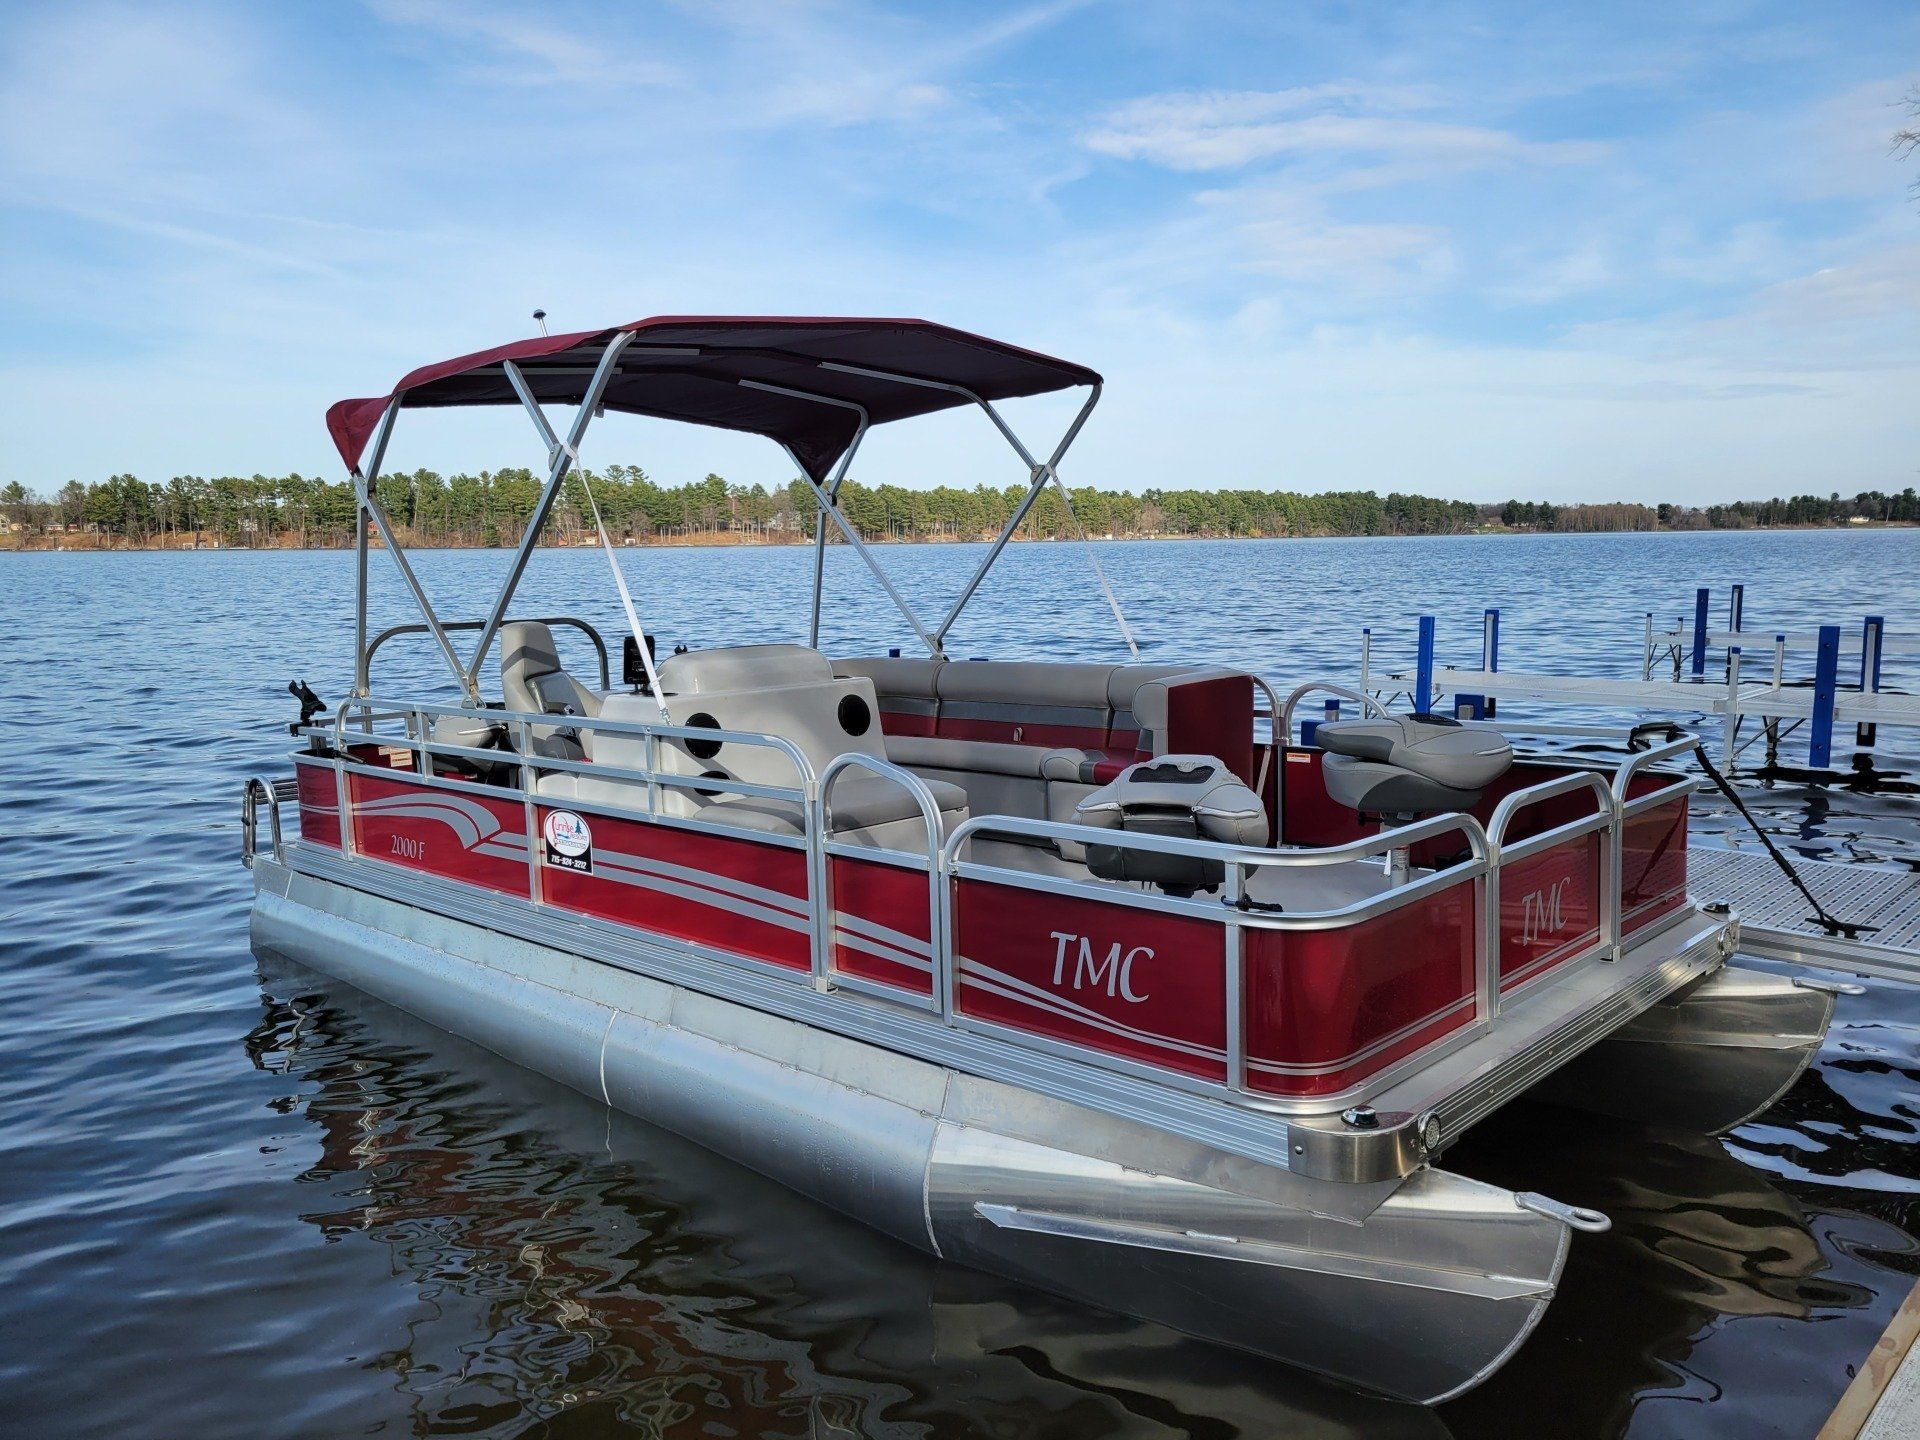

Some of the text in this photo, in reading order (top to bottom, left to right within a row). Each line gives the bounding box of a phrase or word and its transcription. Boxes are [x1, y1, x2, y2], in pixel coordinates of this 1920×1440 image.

[391, 834, 426, 861] 2000 F
[1522, 876, 1571, 947] TMC
[1050, 931, 1155, 1003] TMC
